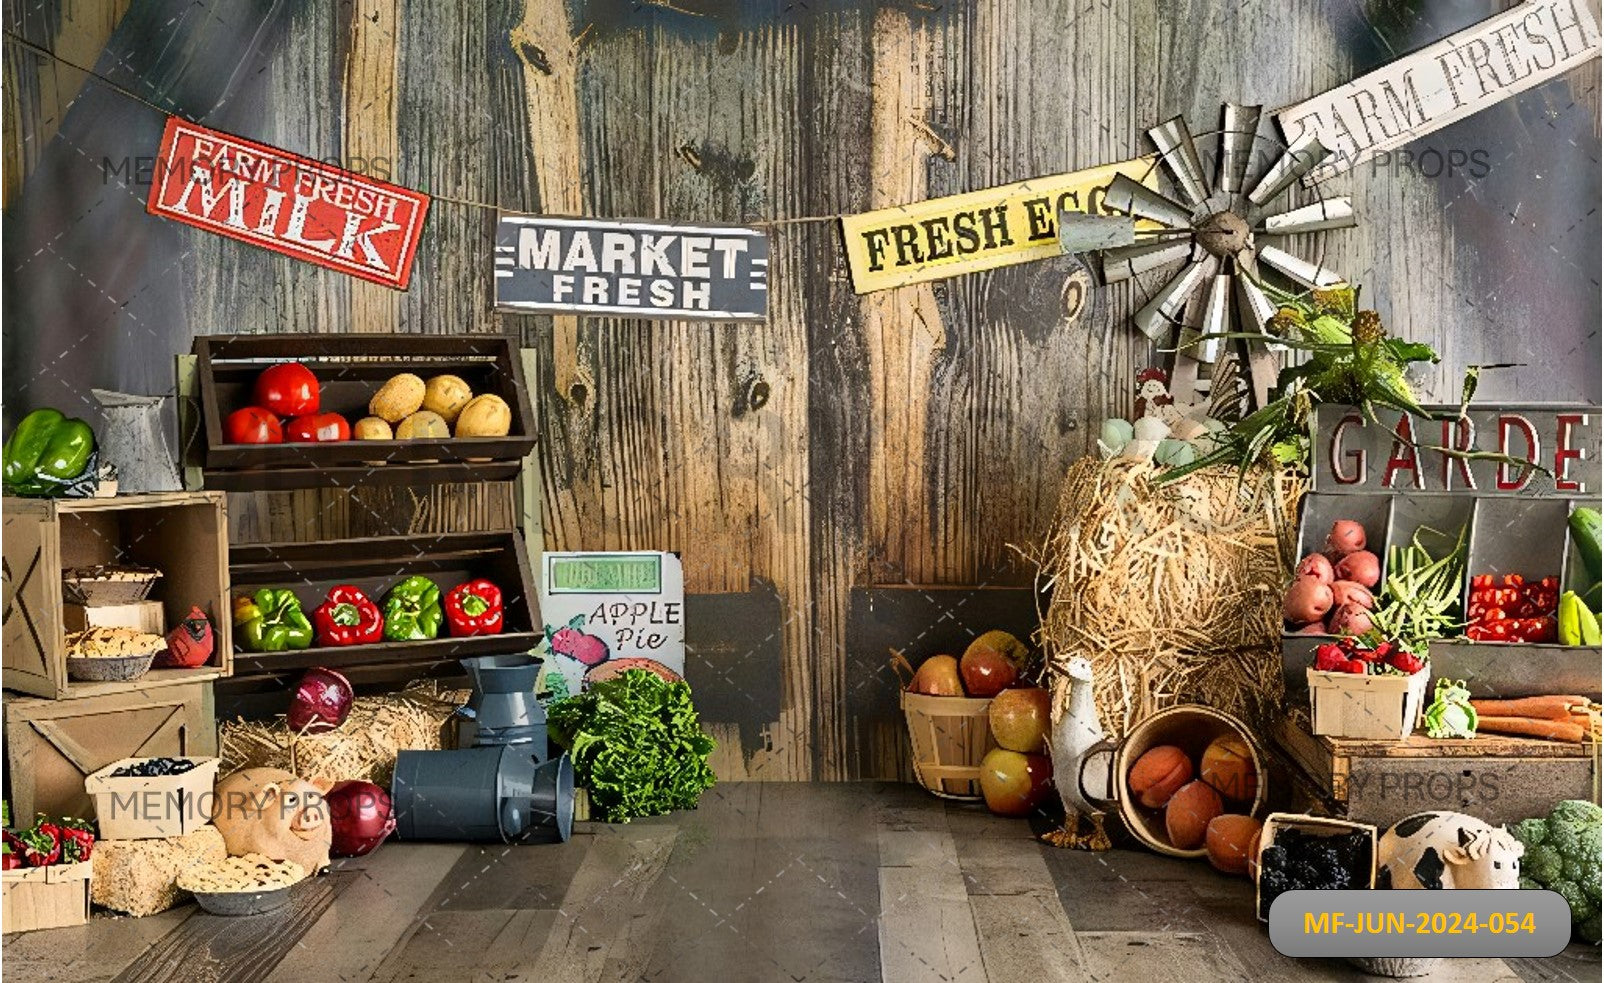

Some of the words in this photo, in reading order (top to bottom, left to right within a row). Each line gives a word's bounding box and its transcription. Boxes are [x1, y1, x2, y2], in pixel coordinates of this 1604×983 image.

[1434, 0, 1597, 110] FRESH
[193, 137, 285, 188] FARM
[295, 171, 399, 223] FRESH
[171, 165, 401, 272] MILK
[518, 227, 748, 279] MARKET
[861, 204, 1014, 273] FRESH
[553, 275, 711, 310] FRESH
[1330, 410, 1589, 492] GARDE
[589, 601, 681, 625] APPLE
[615, 627, 669, 651] Pie
